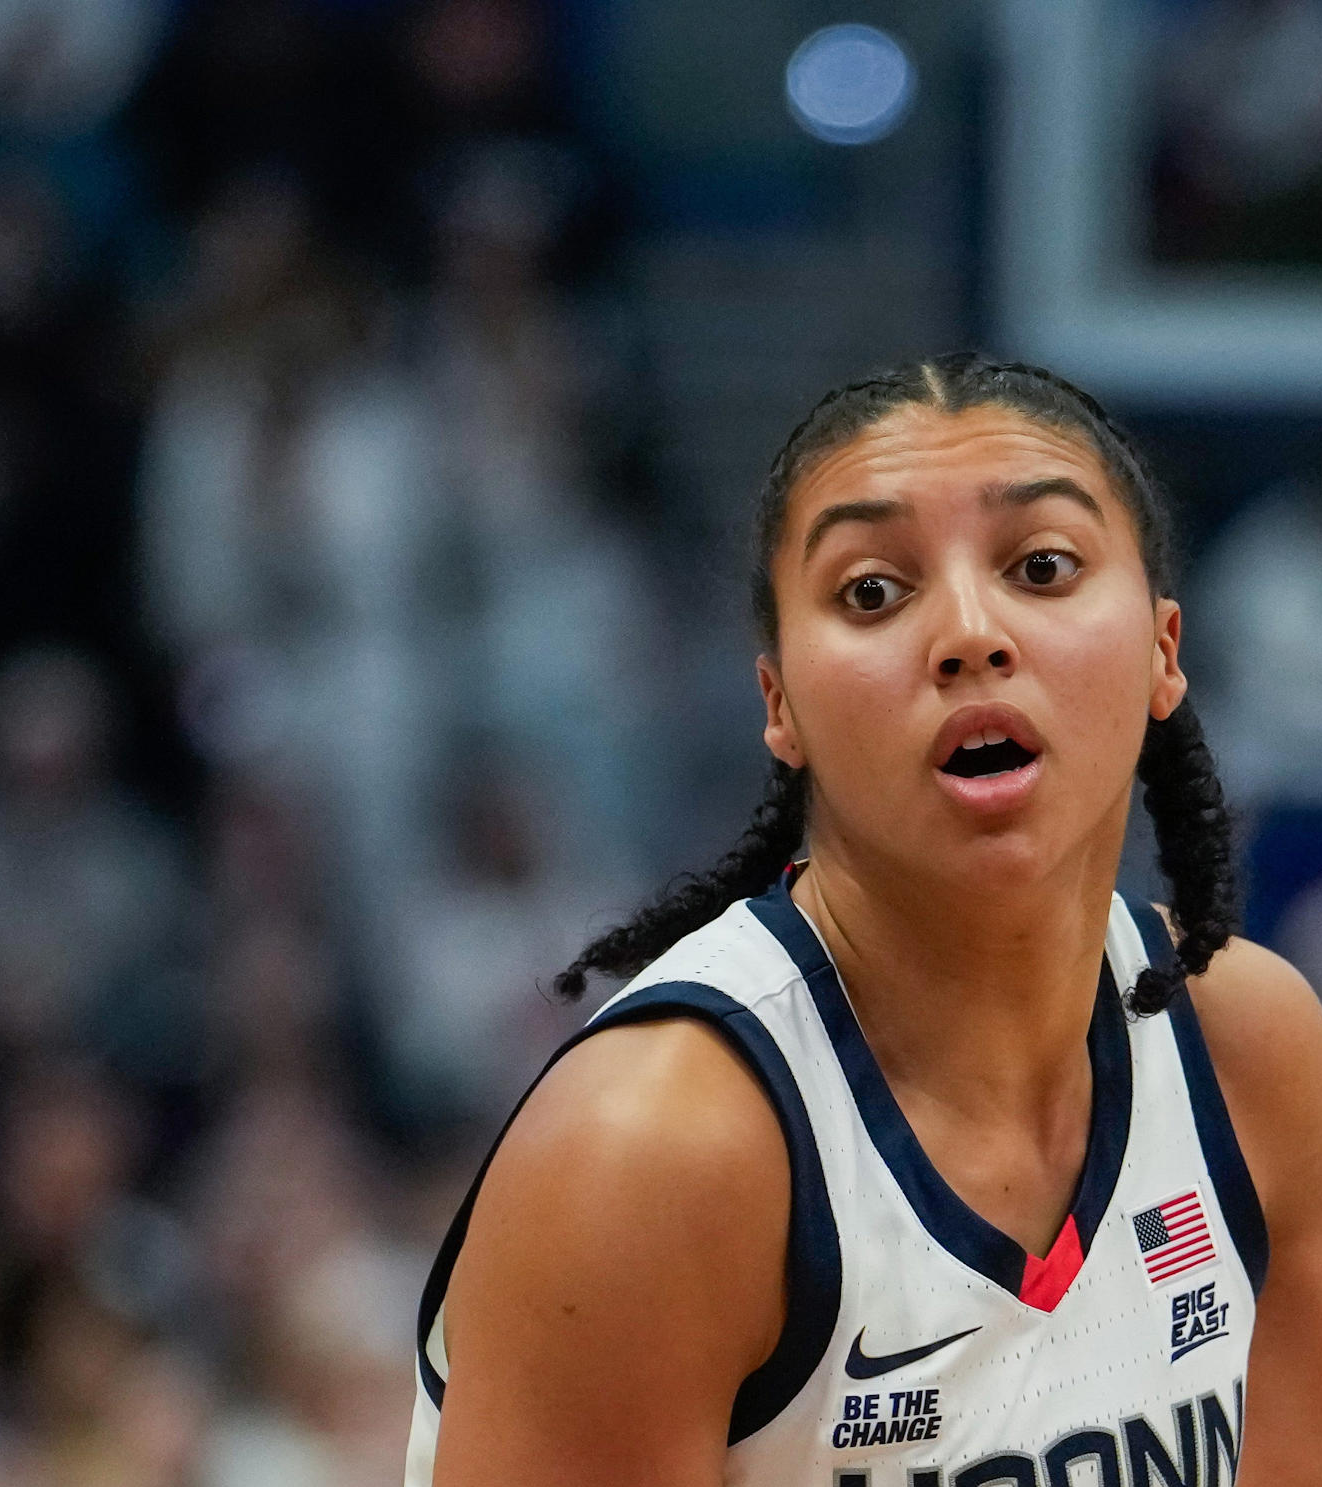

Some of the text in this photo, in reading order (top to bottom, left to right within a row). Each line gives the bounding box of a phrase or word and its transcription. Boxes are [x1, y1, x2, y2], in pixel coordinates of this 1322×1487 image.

[1172, 1281, 1215, 1322] BIG
[1171, 1302, 1229, 1347] EAST
[843, 1389, 939, 1420] BE THE
[832, 1416, 942, 1449] CHANGE
